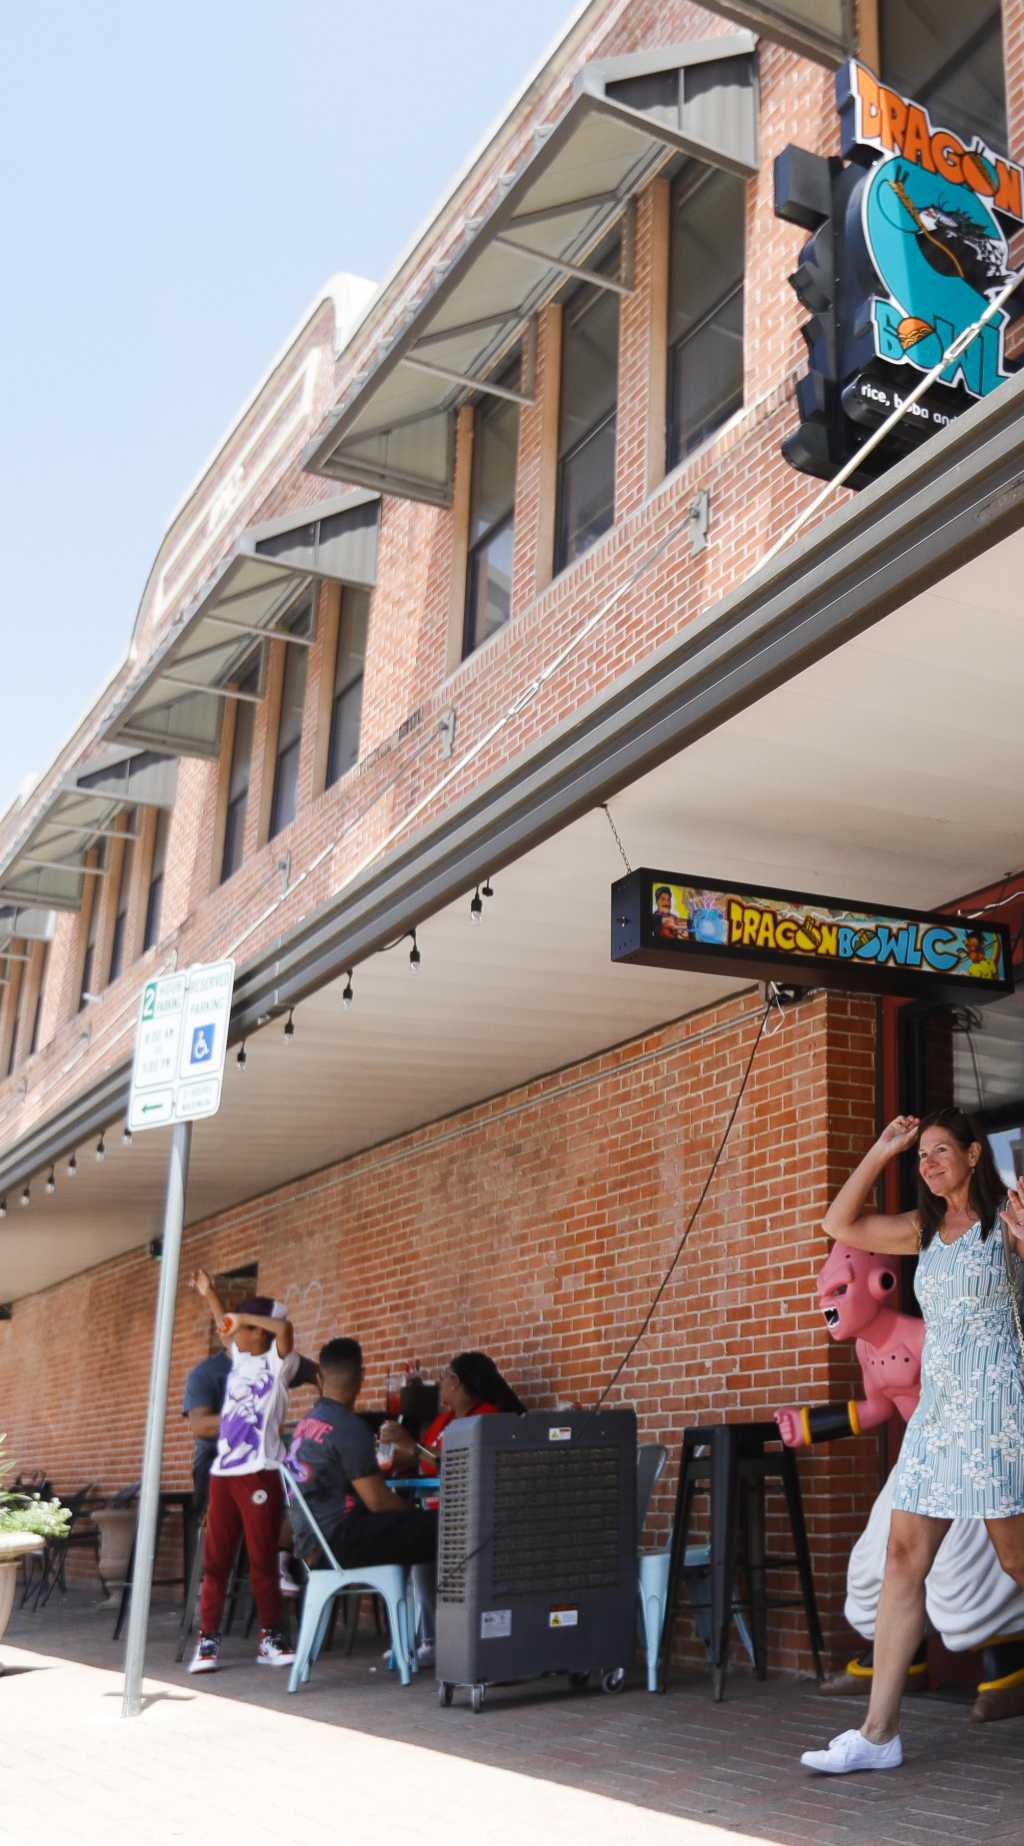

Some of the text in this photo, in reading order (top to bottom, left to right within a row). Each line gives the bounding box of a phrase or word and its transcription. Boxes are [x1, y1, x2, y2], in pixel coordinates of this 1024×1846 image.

[856, 66, 1023, 219] DRAGON
[875, 300, 1009, 398] BOWL
[861, 384, 890, 406] rice,
[894, 393, 929, 419] bba
